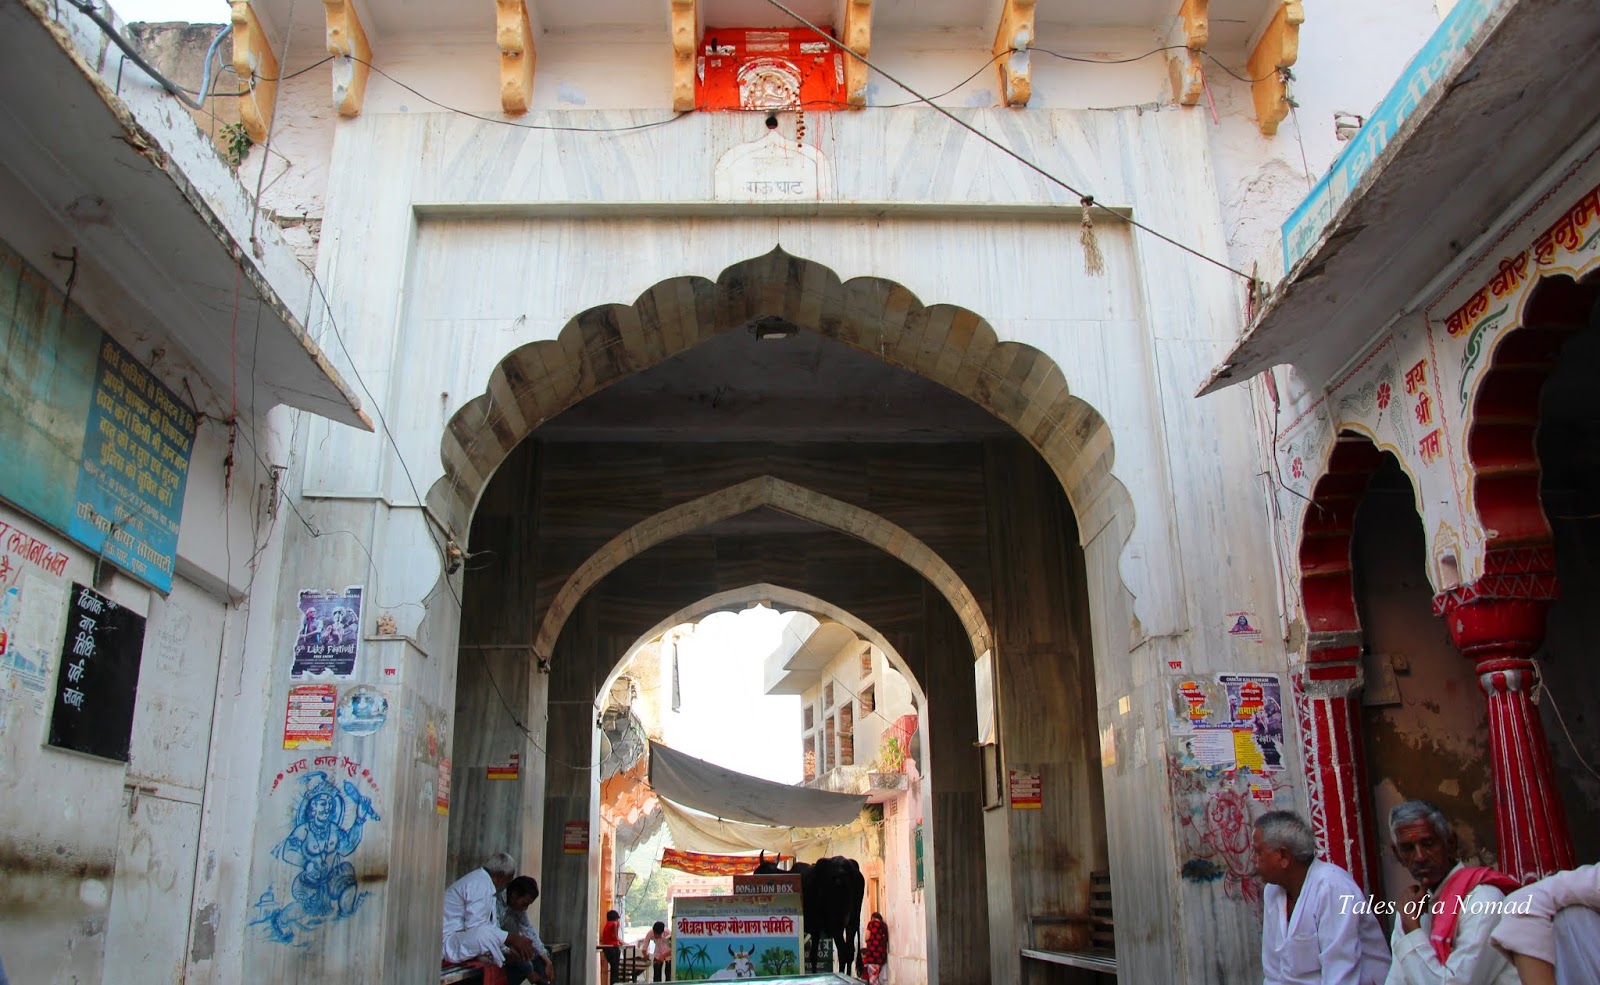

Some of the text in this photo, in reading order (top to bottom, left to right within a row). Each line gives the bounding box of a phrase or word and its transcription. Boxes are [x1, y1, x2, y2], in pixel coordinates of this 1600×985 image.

[774, 181, 803, 194] घाट
[1444, 286, 1490, 337] बाल
[1405, 359, 1427, 395] जय
[1415, 391, 1432, 425] श्री
[1419, 429, 1442, 467] राम
[1168, 661, 1182, 669] राम
[777, 884, 794, 893] BOX
[705, 920, 728, 936] पुष्कर
[728, 917, 762, 935] गौशाला
[762, 916, 794, 934] समिति
